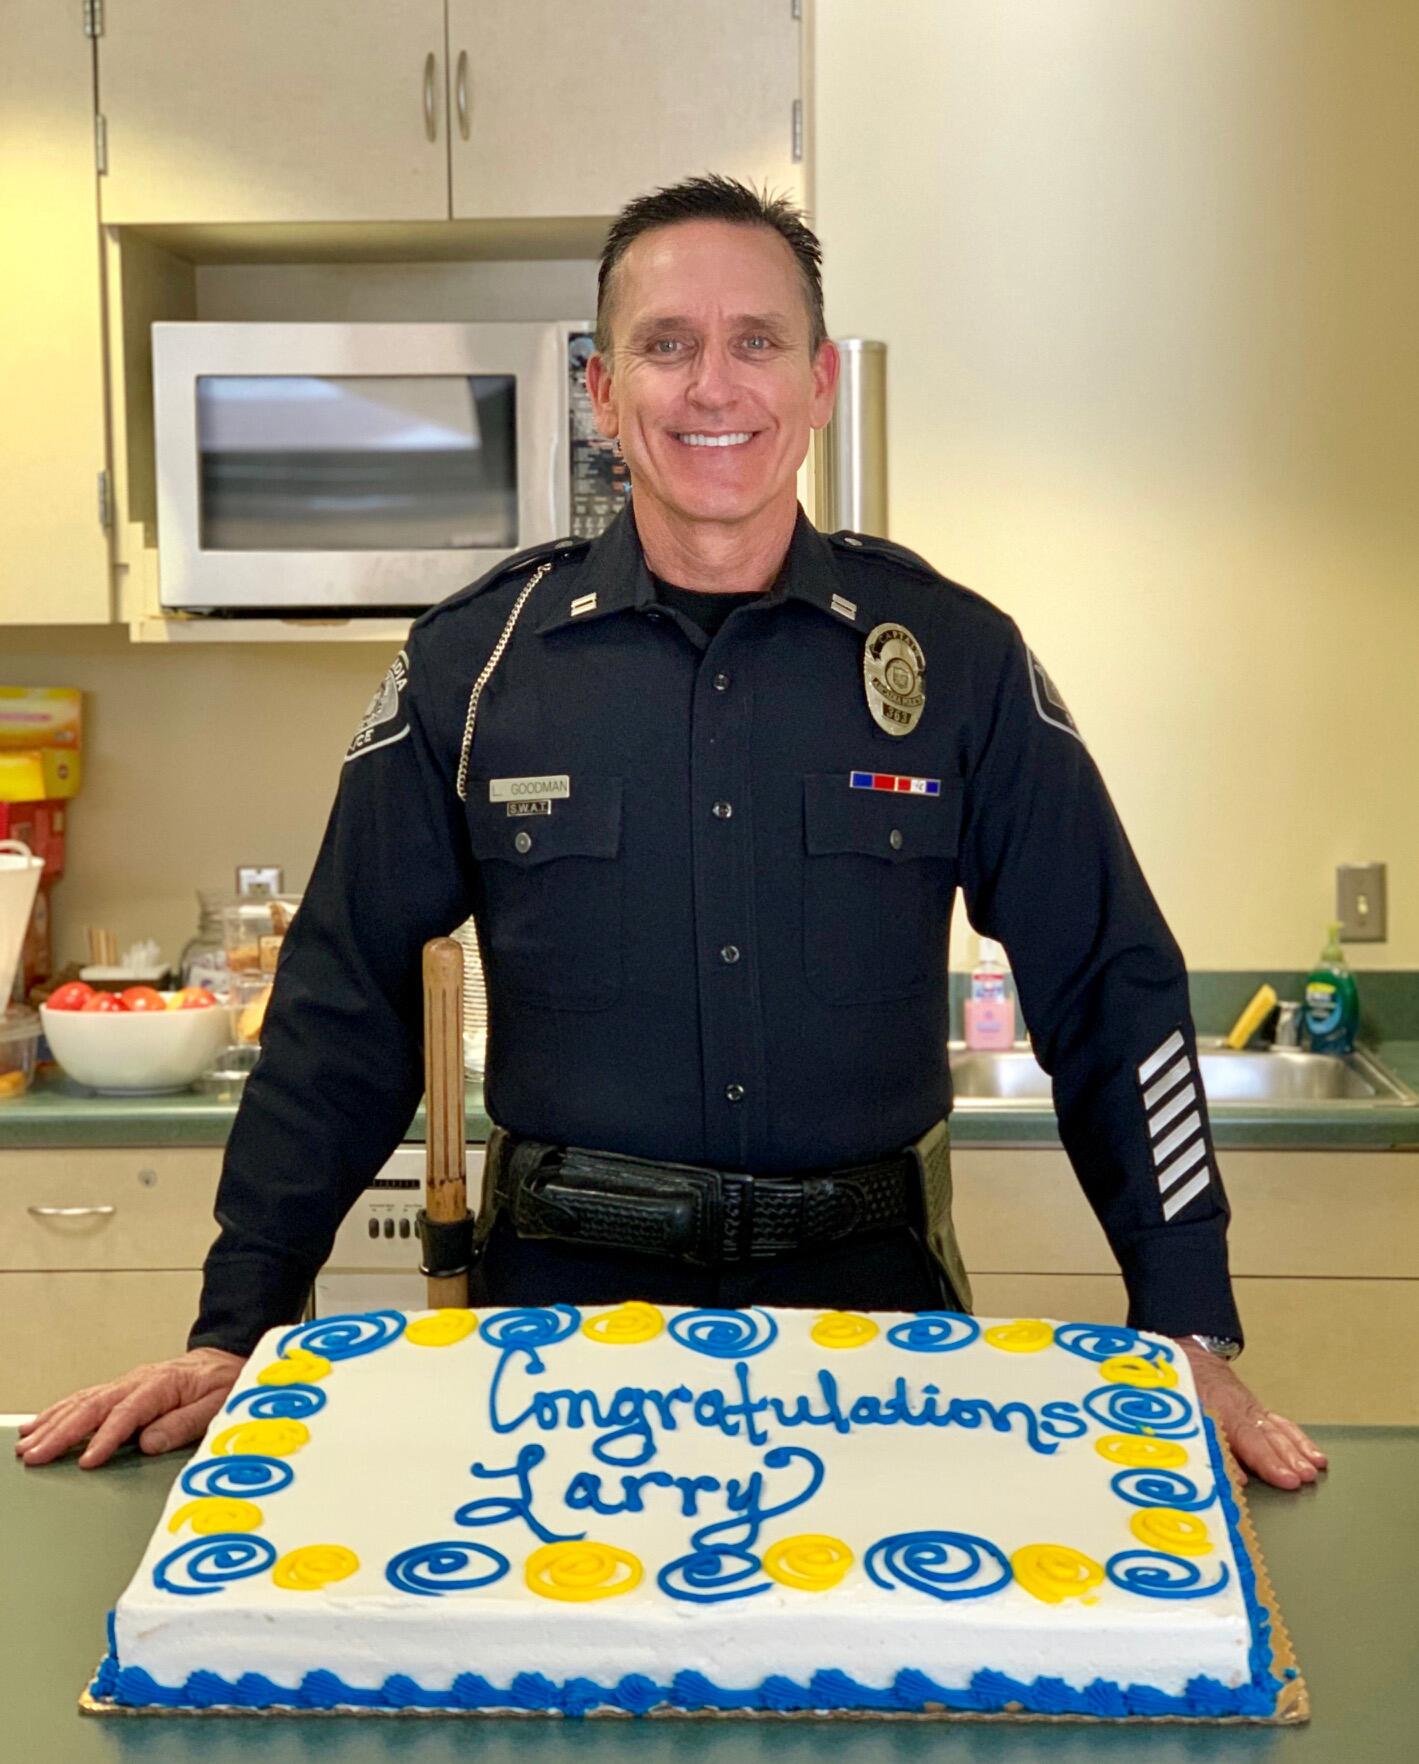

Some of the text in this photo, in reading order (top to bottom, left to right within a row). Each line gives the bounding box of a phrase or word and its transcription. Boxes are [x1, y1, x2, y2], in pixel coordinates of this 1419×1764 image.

[511, 780, 568, 795] GOODMAN
[489, 1340, 1088, 1467] Congratulations
[454, 1443, 825, 1552] Larry
